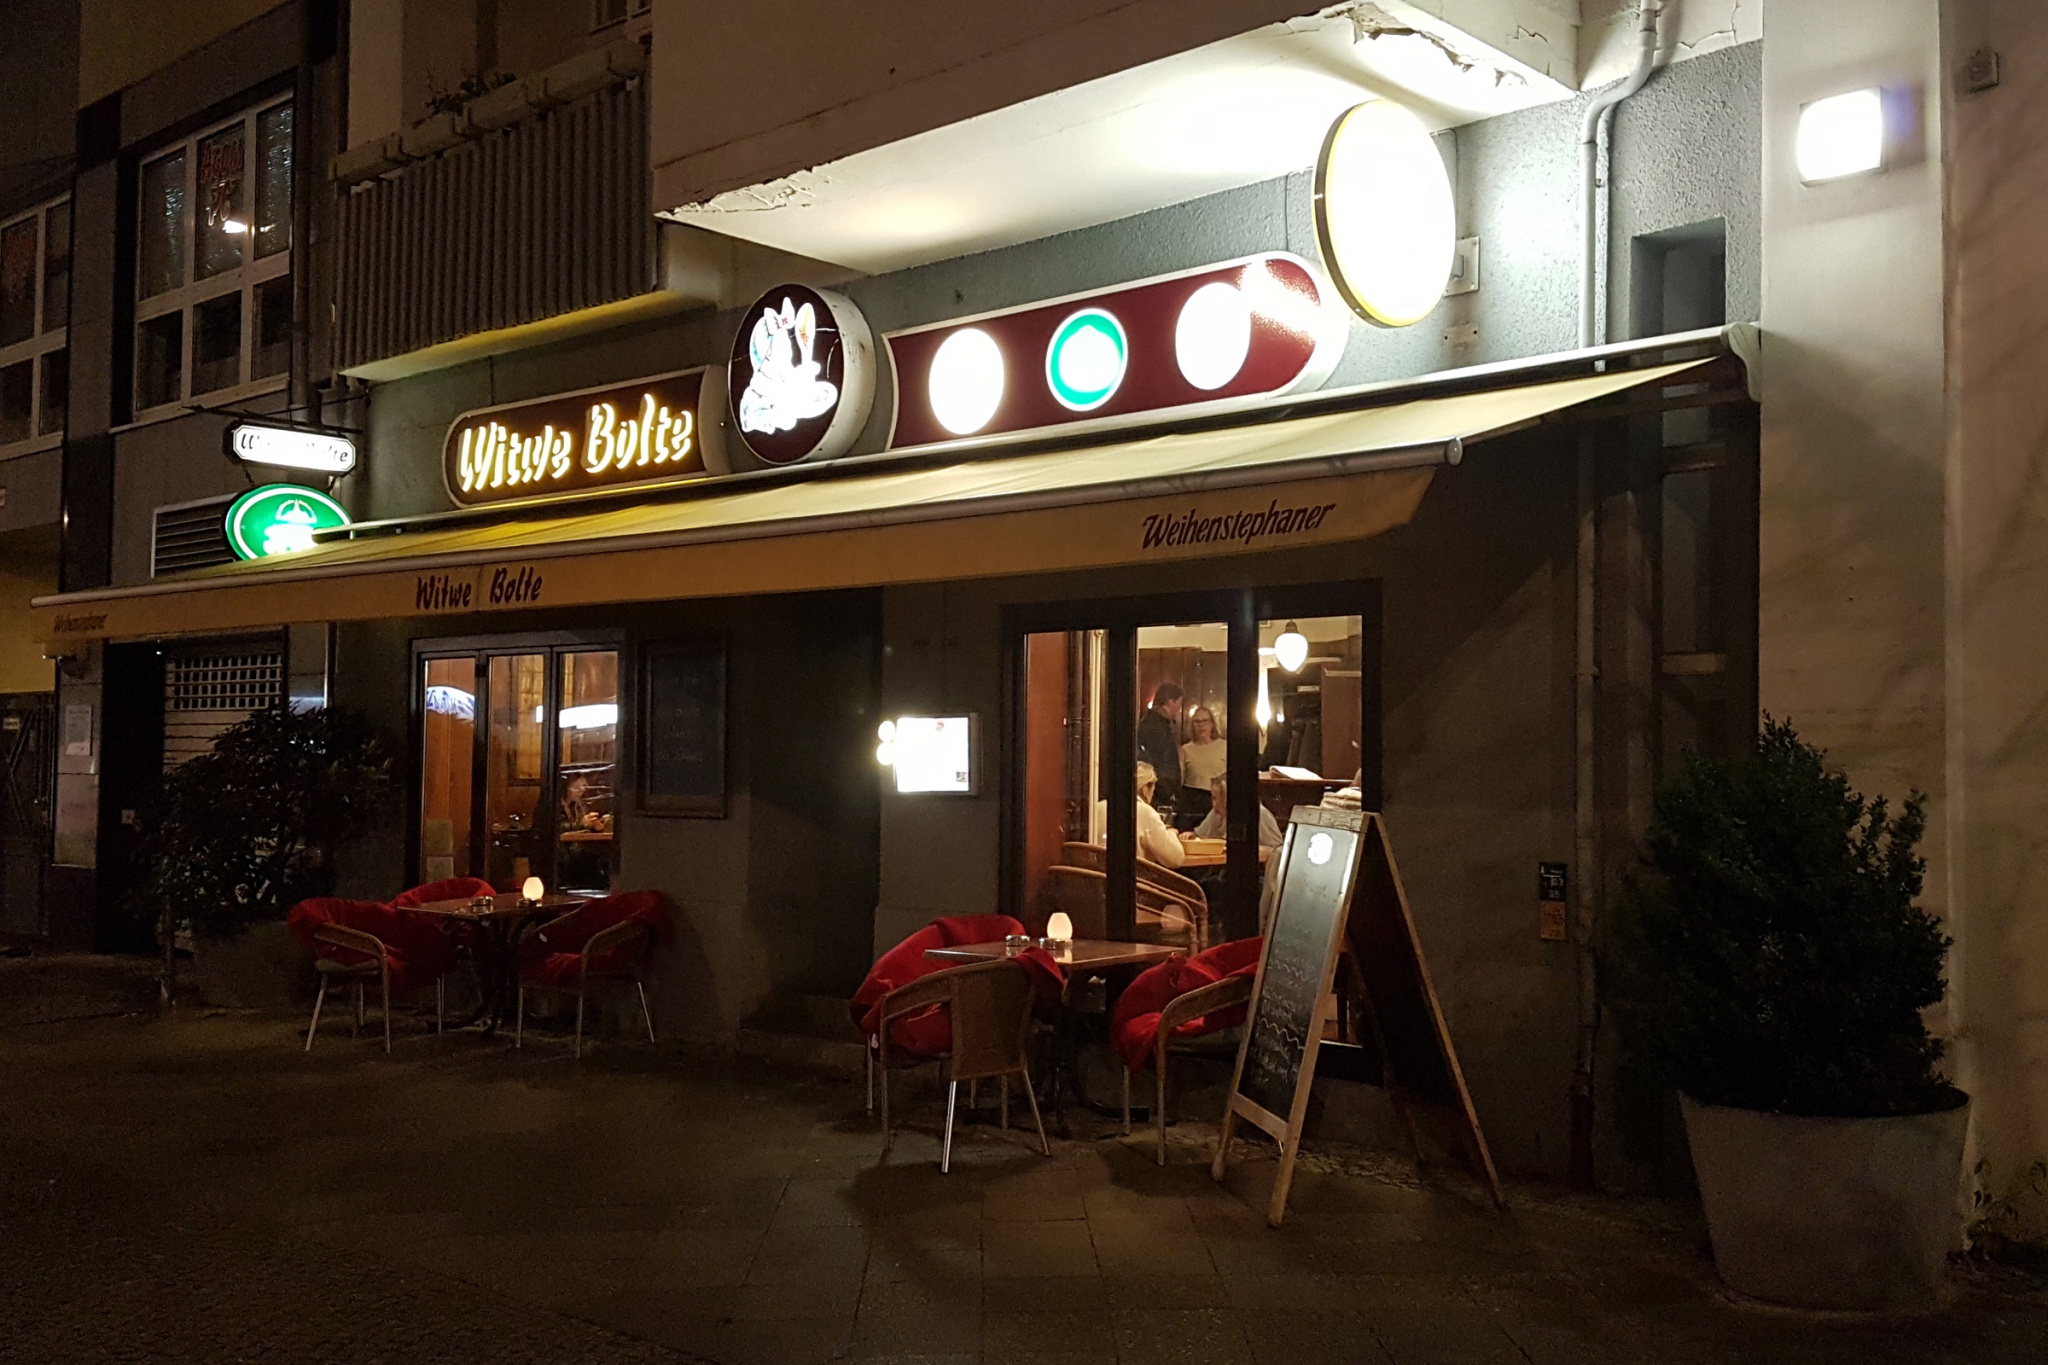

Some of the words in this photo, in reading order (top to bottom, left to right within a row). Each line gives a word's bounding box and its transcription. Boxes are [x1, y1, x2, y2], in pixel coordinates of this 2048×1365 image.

[459, 420, 572, 493] Witwe
[583, 392, 693, 474] Bolte
[1142, 499, 1337, 549] Weihenstephaner
[416, 575, 472, 610] Witwe
[489, 566, 543, 604] Bolte
